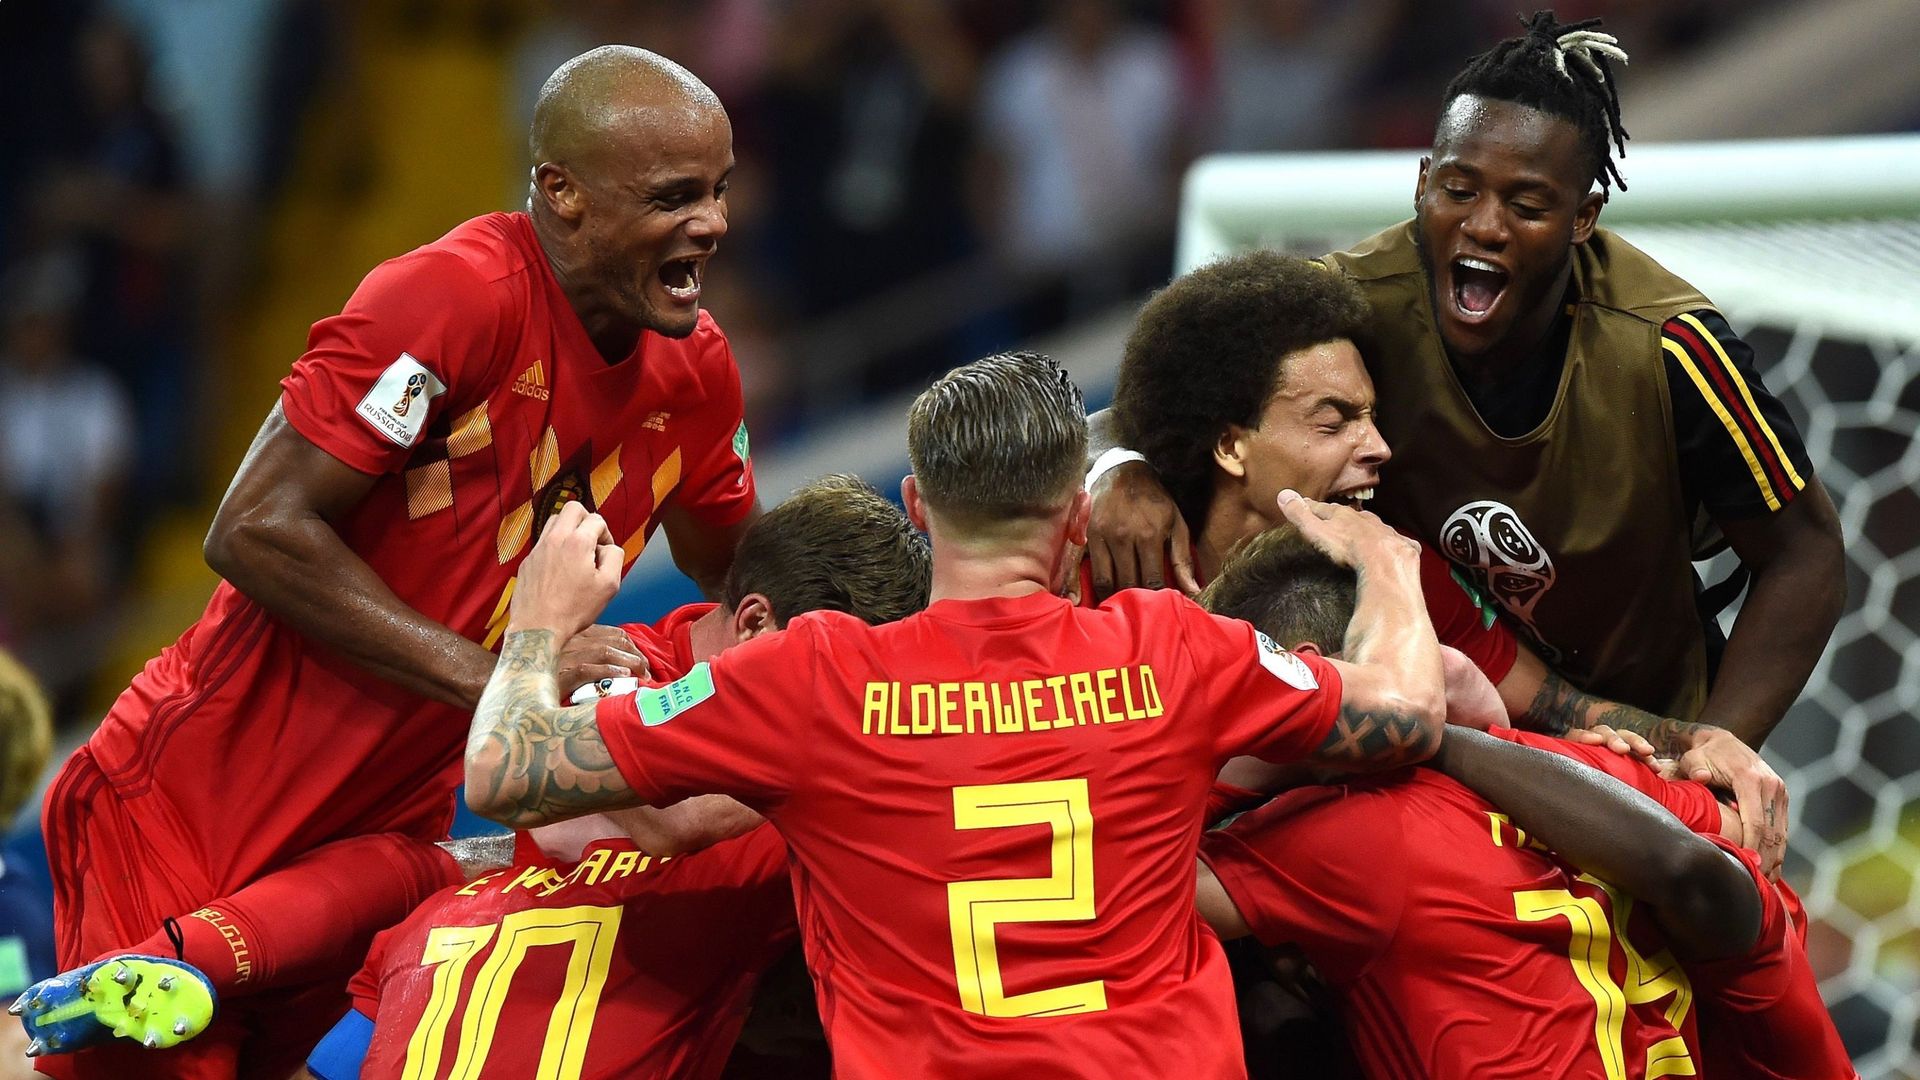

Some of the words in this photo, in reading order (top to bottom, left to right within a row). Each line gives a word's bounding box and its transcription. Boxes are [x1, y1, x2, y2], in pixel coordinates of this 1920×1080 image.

[363, 403, 395, 431] RUSSIA
[394, 427, 413, 442] 2018
[511, 381, 550, 401] adidas
[659, 694, 671, 715] FIFA
[862, 664, 1164, 735] ALDERWEIRELD
[947, 778, 1109, 1018] 2
[190, 908, 252, 984] BELGIUM
[400, 904, 625, 1080] 10
